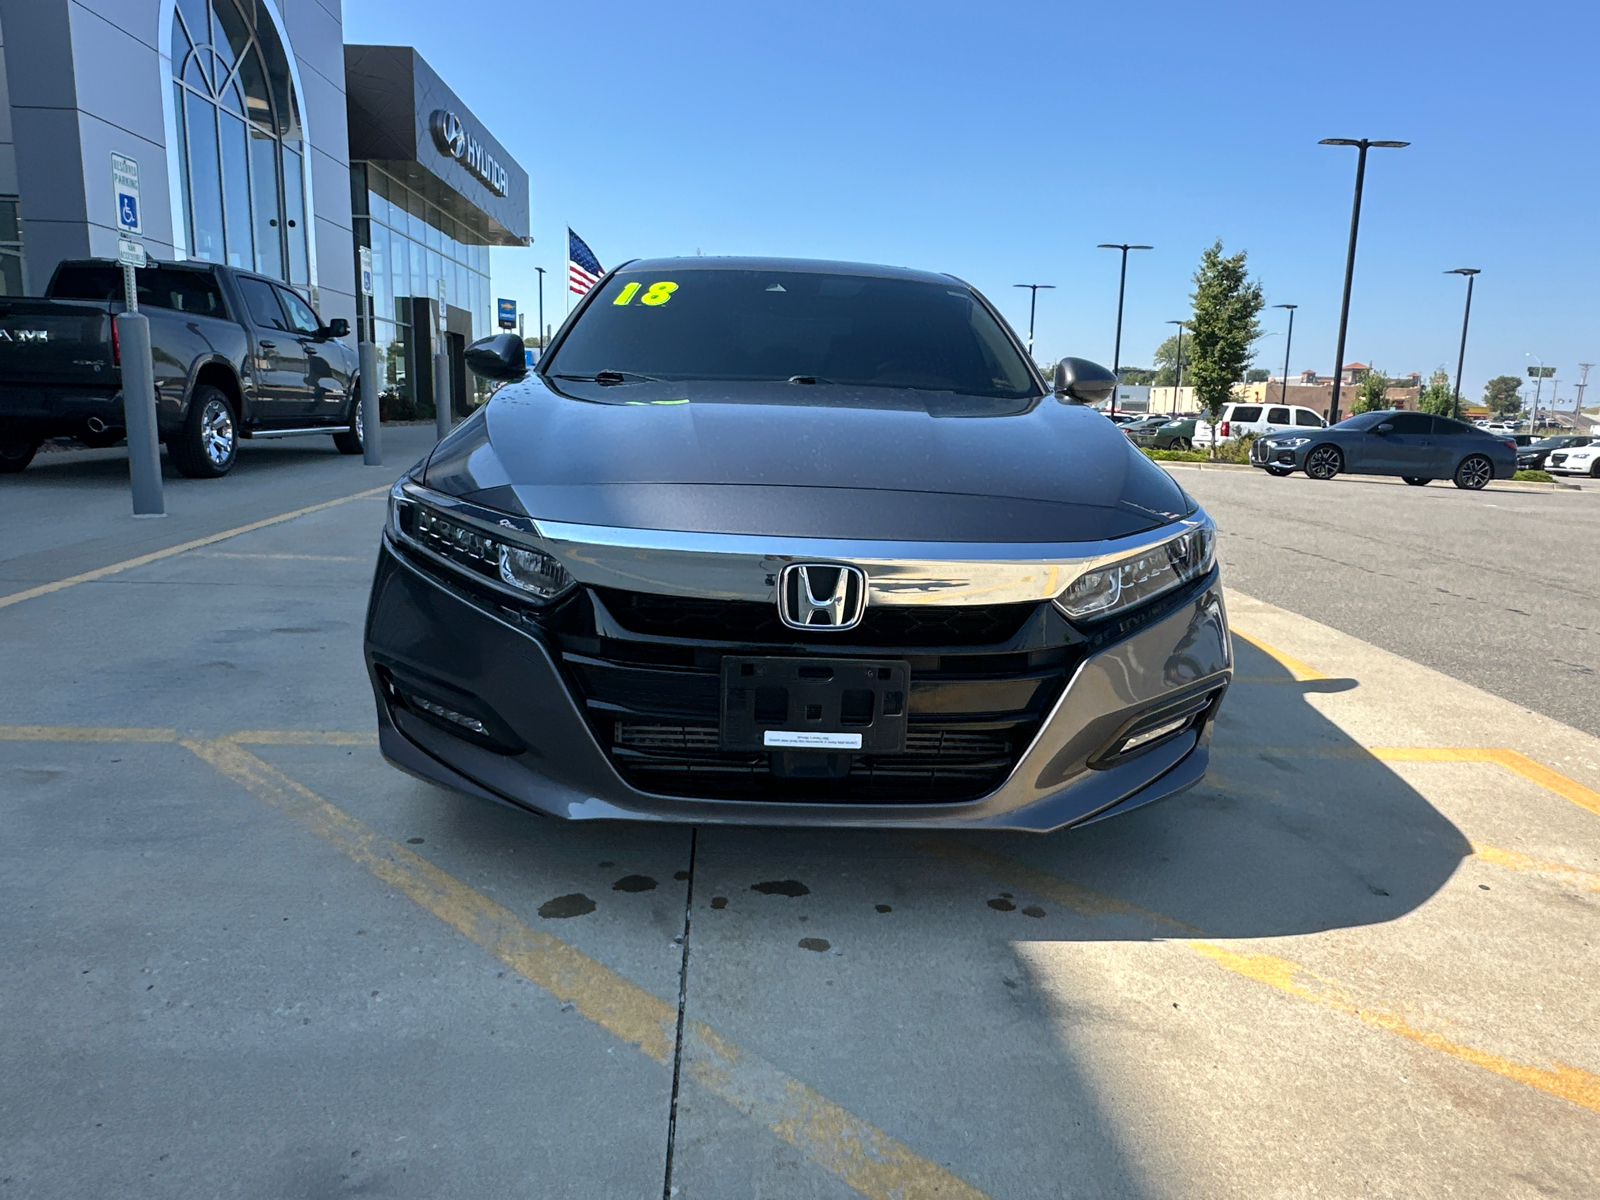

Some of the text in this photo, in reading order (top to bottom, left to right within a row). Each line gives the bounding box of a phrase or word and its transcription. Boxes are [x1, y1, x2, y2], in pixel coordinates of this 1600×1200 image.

[467, 133, 509, 198] HYUNDAI
[114, 173, 138, 190] PARKING
[612, 281, 679, 306] 18
